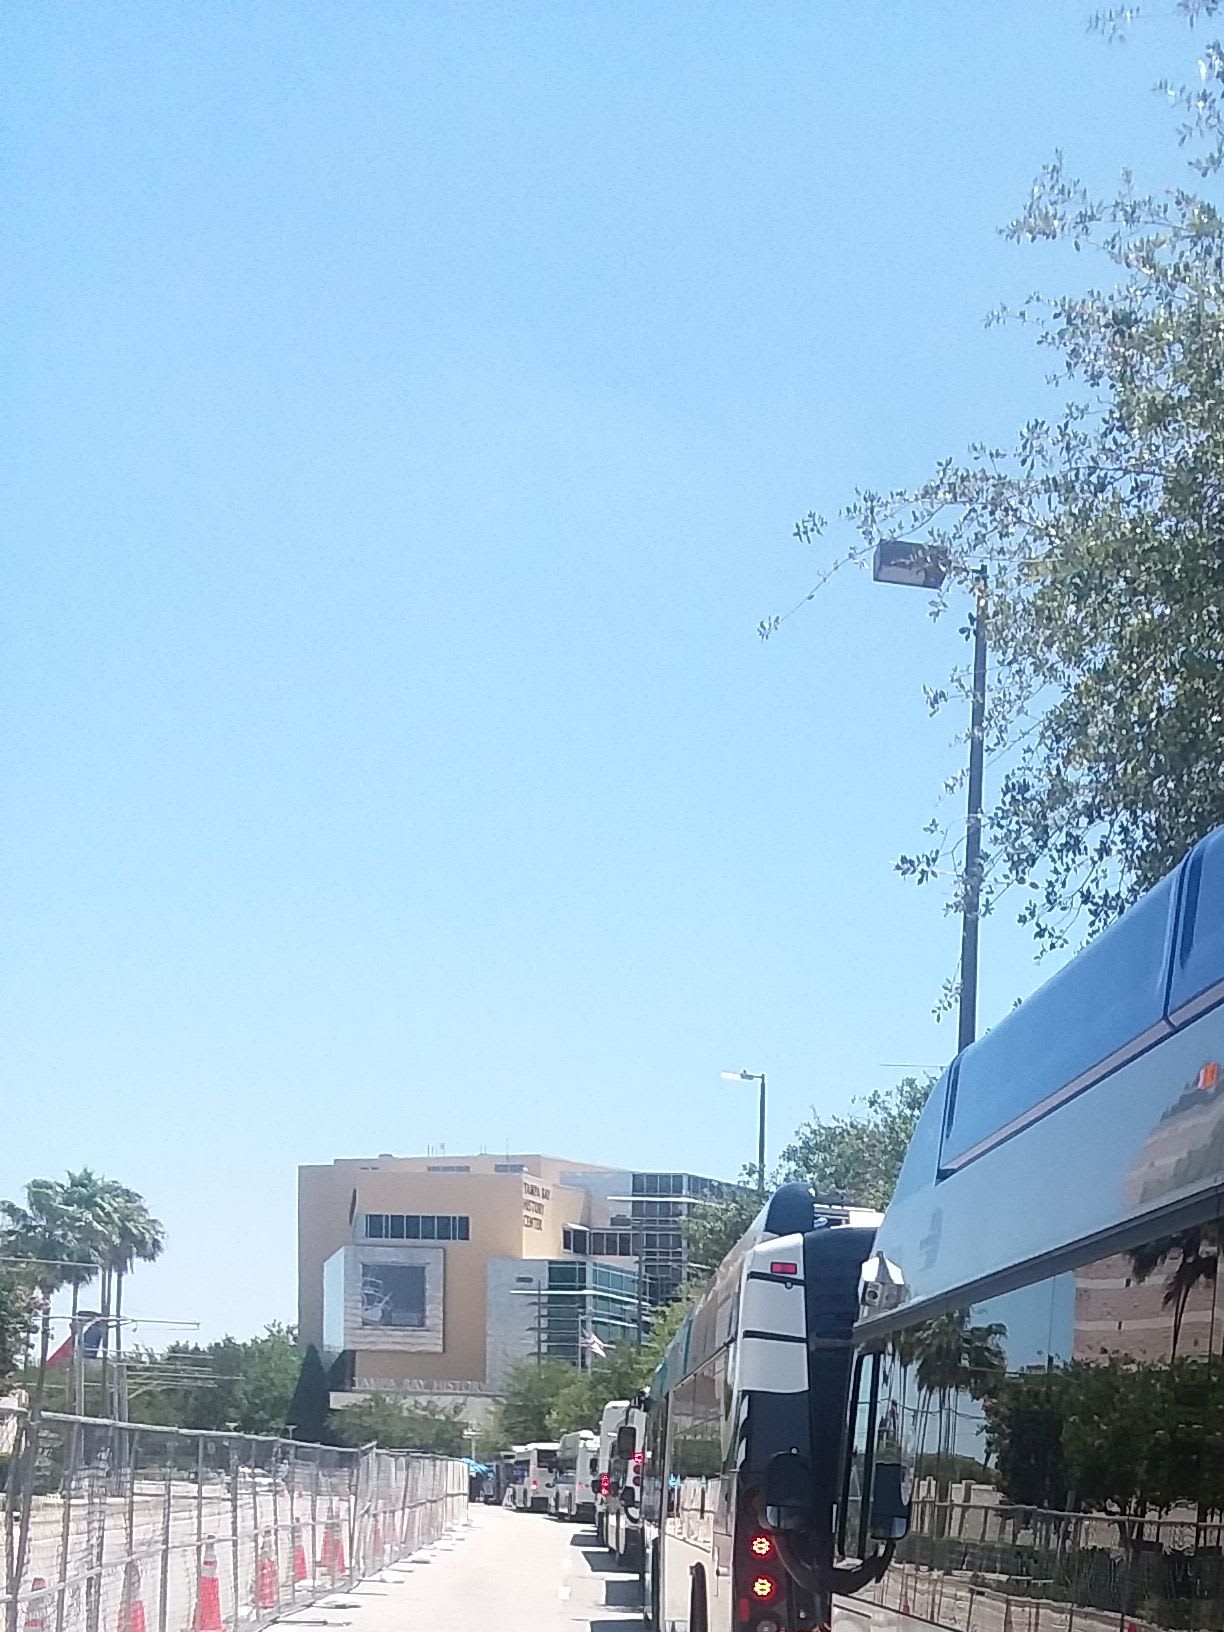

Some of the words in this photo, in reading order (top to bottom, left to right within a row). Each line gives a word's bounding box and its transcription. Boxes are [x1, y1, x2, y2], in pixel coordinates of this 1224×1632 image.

[523, 1214, 543, 1230] CENTER
[352, 1376, 396, 1389] TAMPA
[403, 1377, 427, 1391] BAY
